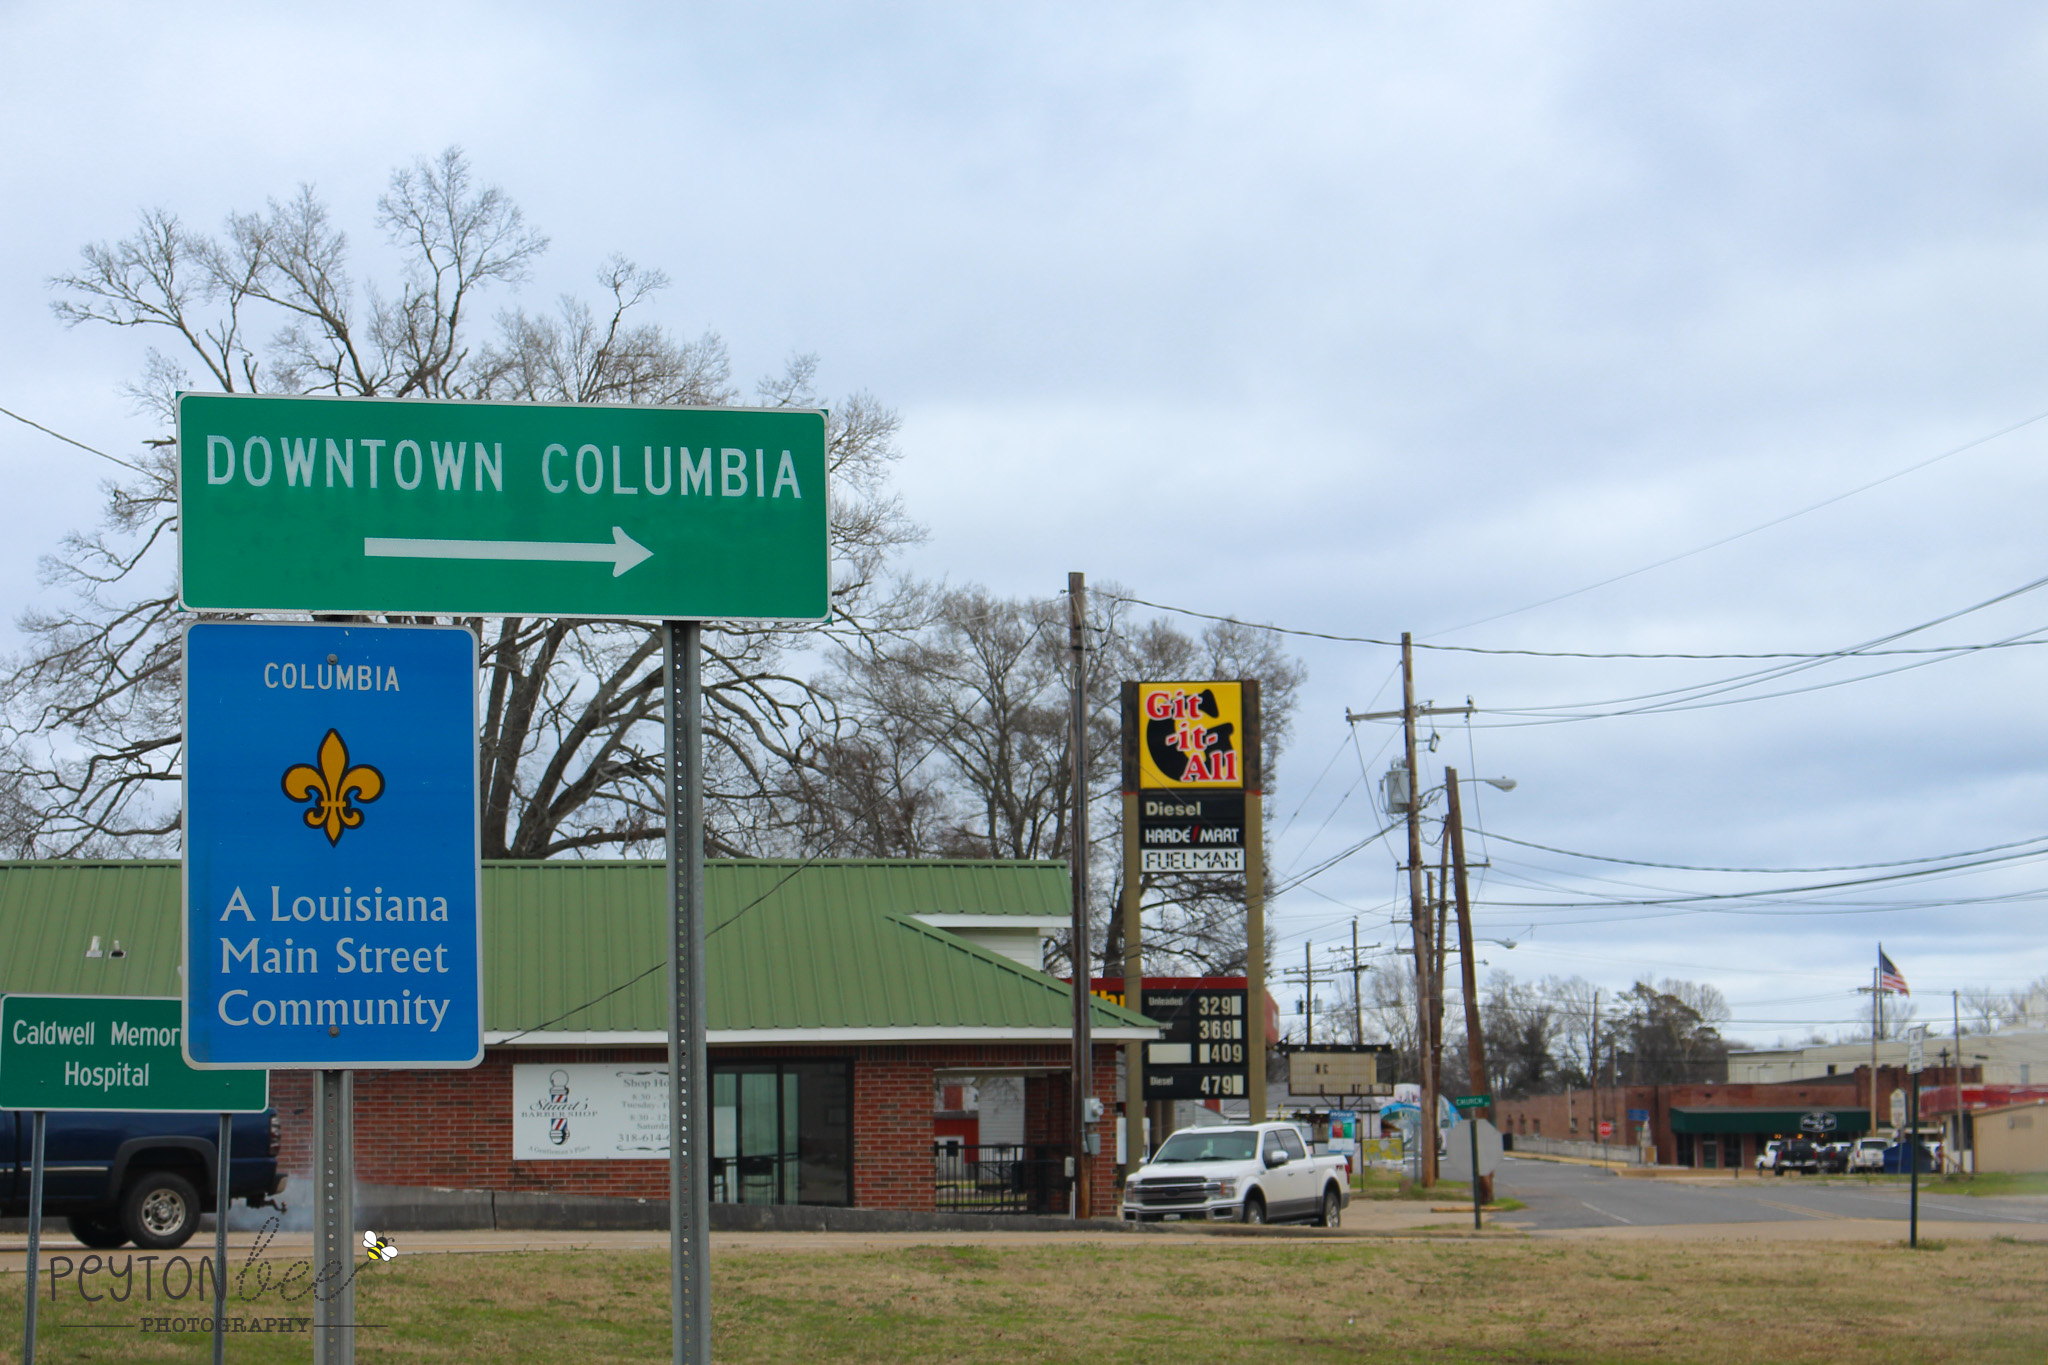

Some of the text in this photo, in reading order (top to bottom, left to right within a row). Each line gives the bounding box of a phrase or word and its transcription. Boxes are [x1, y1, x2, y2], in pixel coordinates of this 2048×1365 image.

[206, 434, 802, 499] DOWNTOWN COLUMBIA
[264, 662, 401, 692] COLUMBIA
[1146, 688, 1203, 720] Git
[1180, 749, 1239, 782] All
[1145, 801, 1201, 816] Diesel
[1200, 828, 1240, 844] MART
[1146, 851, 1239, 869] FUELMAN
[219, 886, 449, 922] A Louisiana
[219, 937, 450, 974] Main Street
[218, 989, 451, 1033] Community
[1148, 996, 1184, 1006] Unleaded
[1199, 996, 1232, 1016] 329
[13, 1019, 95, 1046] Caldwell
[1199, 1019, 1232, 1040] 369
[1211, 1043, 1243, 1063] 409
[65, 1061, 149, 1092] Hospital
[623, 1078, 670, 1089] Shop Ho
[1150, 1076, 1174, 1086] Diesel
[1201, 1075, 1232, 1095] 479
[637, 1122, 670, 1130] Saturda
